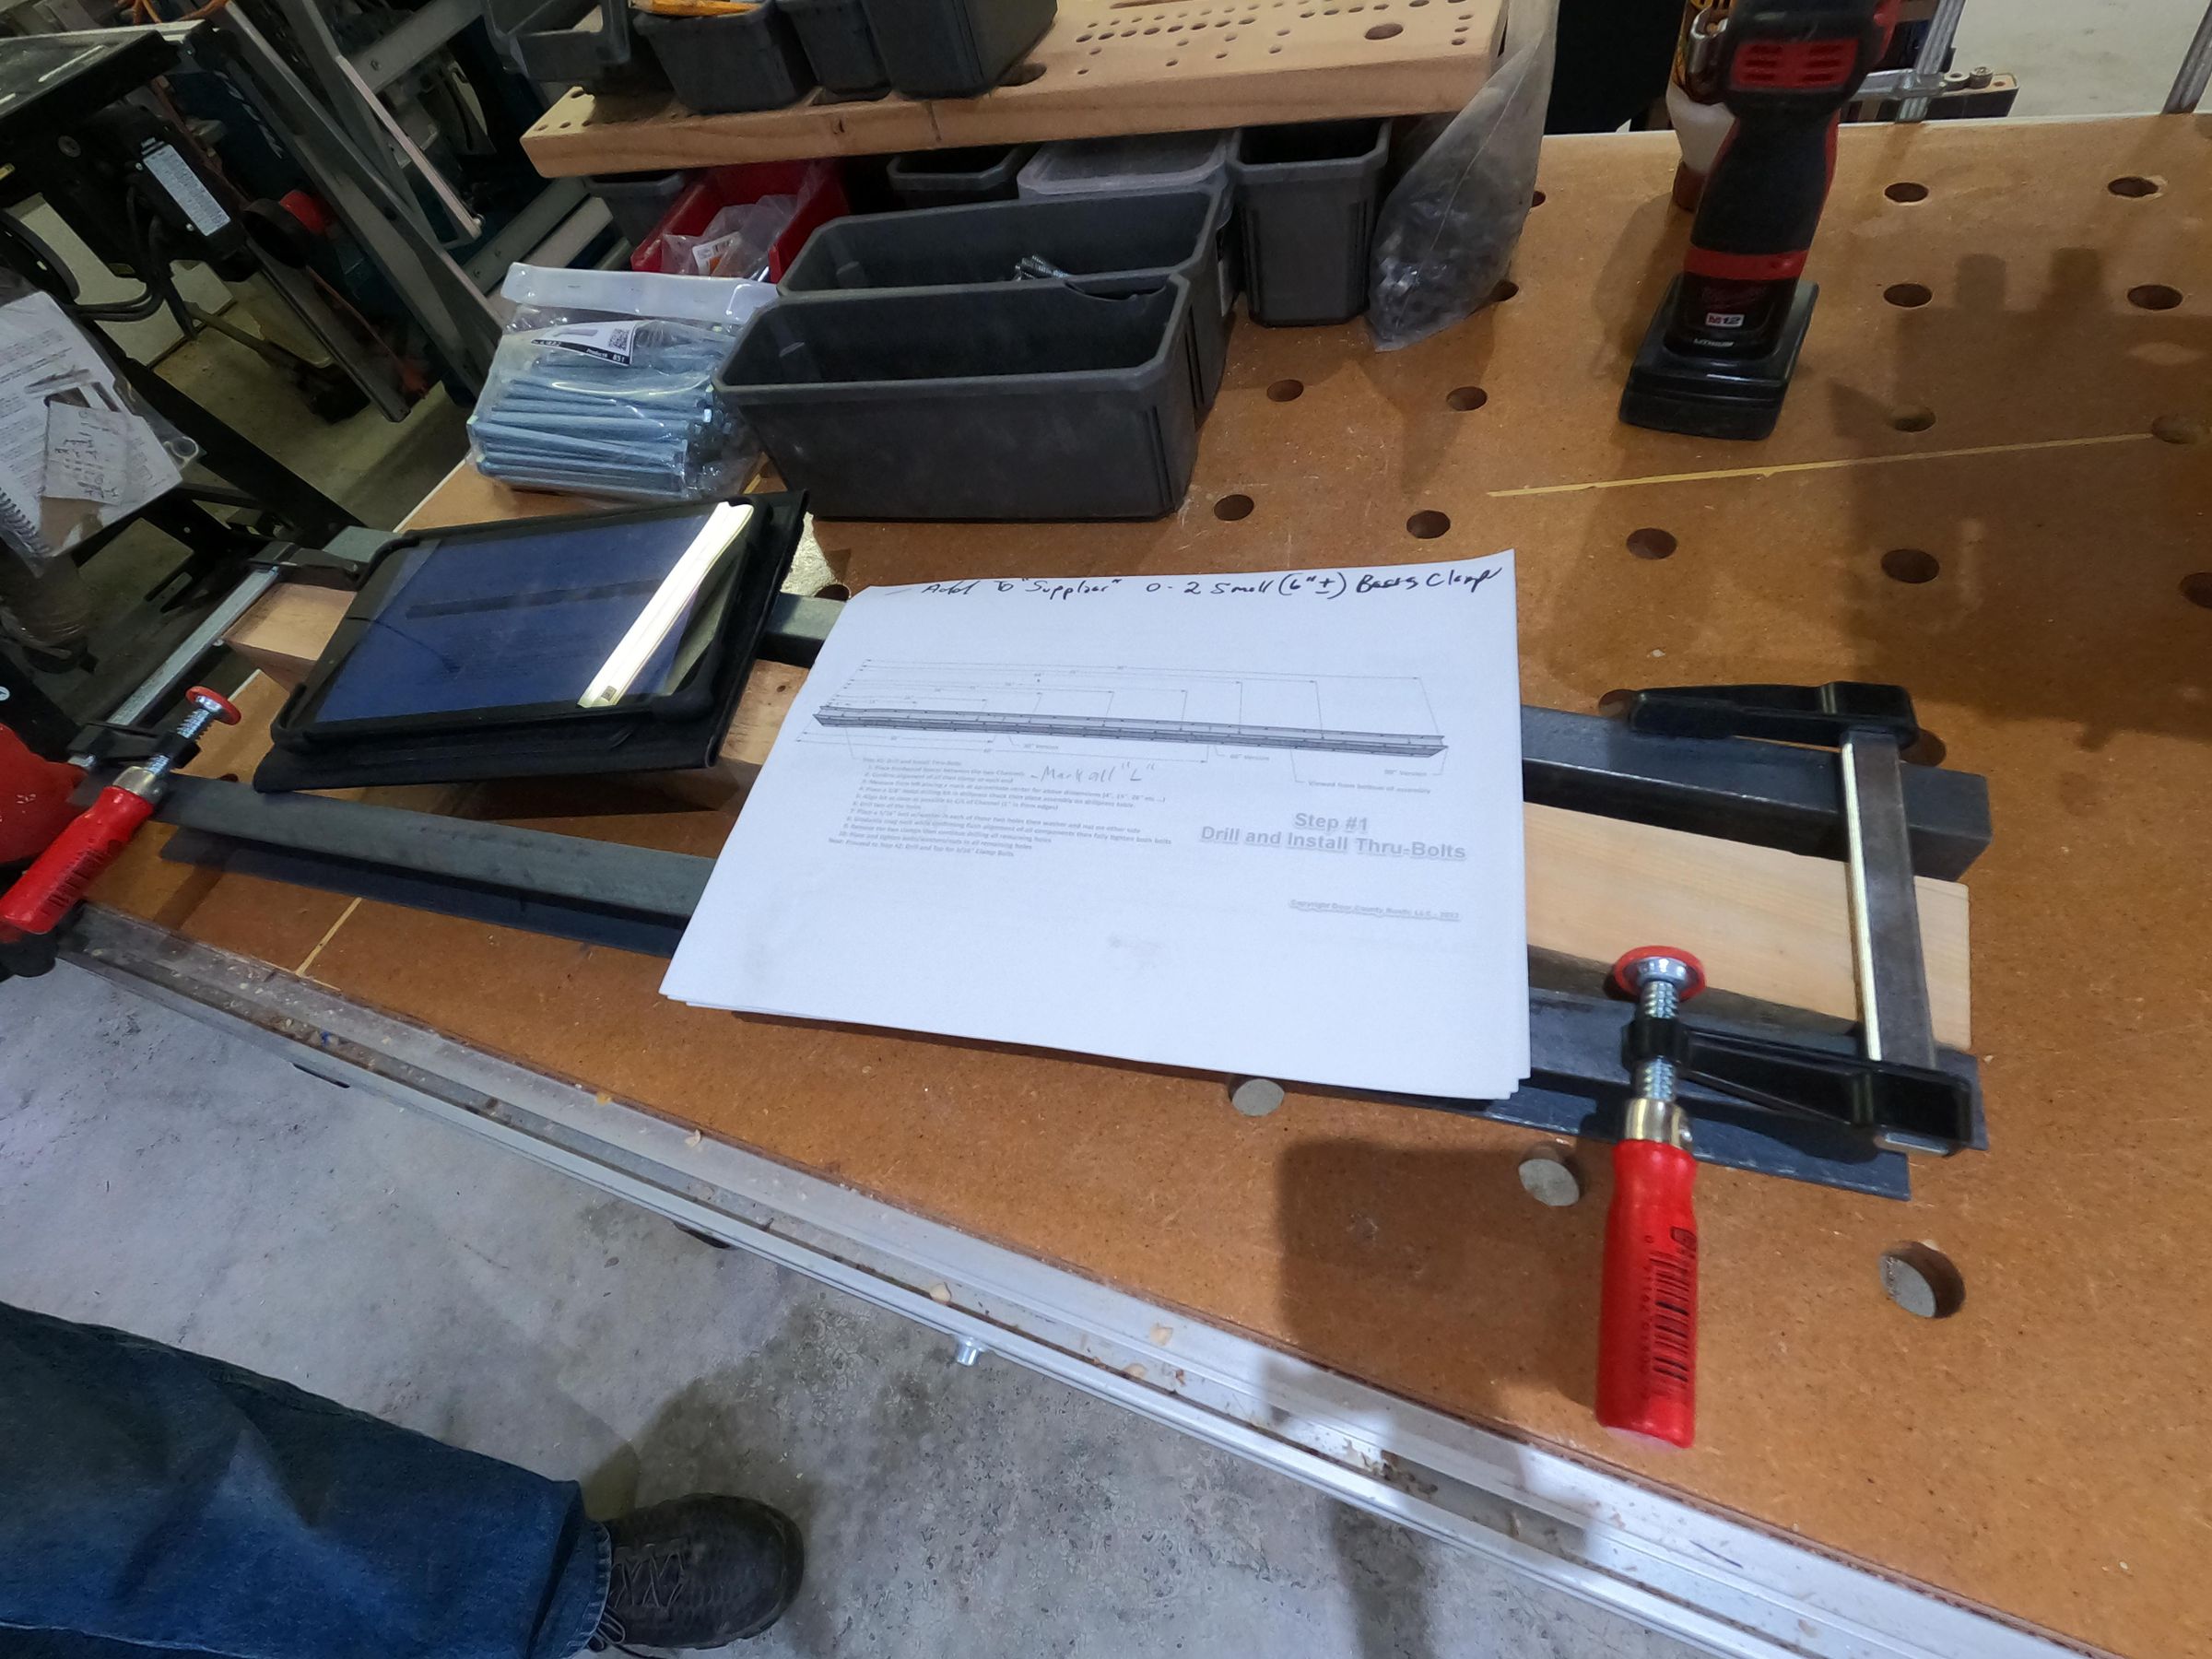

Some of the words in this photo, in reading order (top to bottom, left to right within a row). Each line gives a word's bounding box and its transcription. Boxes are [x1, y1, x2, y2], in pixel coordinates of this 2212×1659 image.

[1709, 315, 1741, 324] M12
[1040, 765, 1083, 782] Mark
[1088, 766, 1116, 782] all
[1294, 812, 1339, 833] Step
[1345, 816, 1369, 833] #1
[1201, 825, 1240, 843] Drill
[1244, 830, 1281, 846] and
[1288, 831, 1348, 852] Install
[1355, 837, 1467, 860] Thru-Bolts
[1290, 900, 1330, 910] Copyright
[1355, 905, 1383, 914] County
